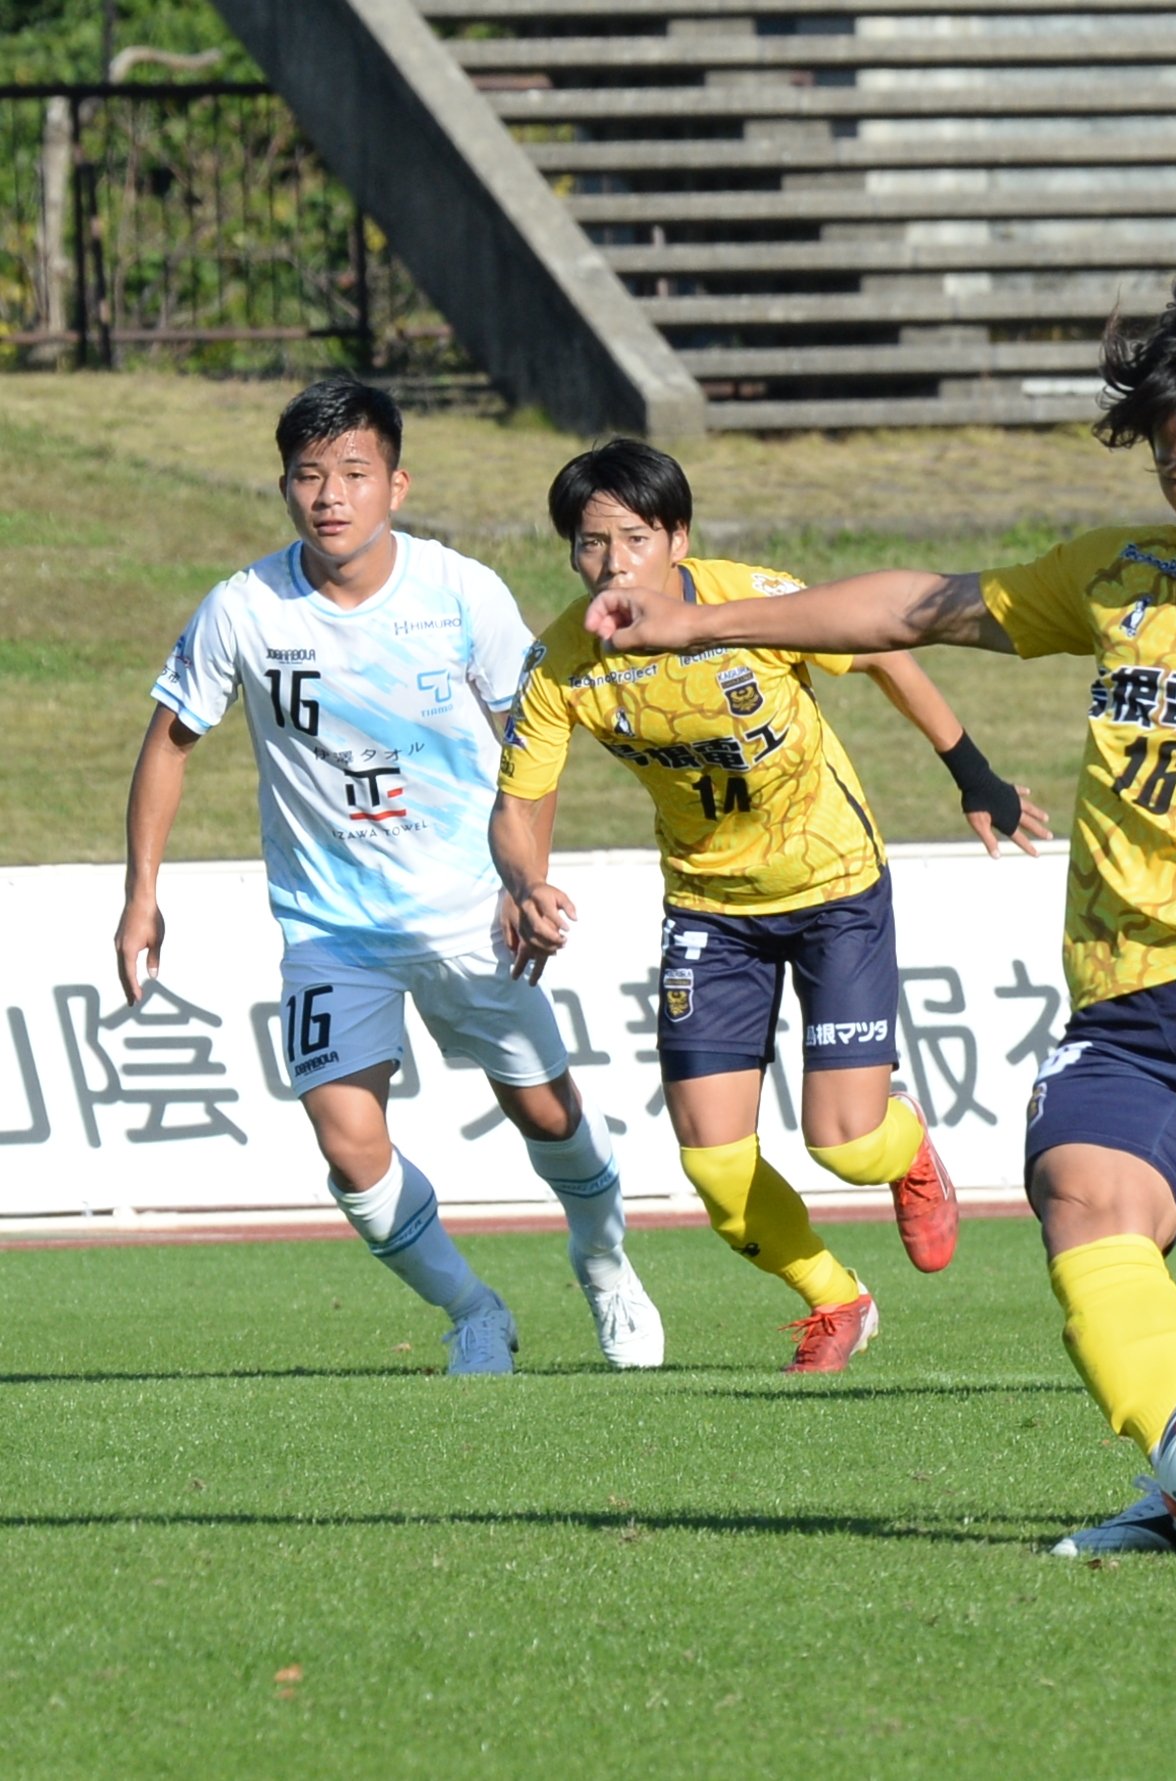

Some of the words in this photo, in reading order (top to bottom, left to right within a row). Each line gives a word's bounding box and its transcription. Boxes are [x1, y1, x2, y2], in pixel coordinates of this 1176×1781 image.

[410, 618, 462, 631] HIMURO
[264, 669, 321, 737] 16
[691, 774, 752, 821] 14
[383, 820, 428, 837] TOWEL
[286, 985, 334, 1063] 16
